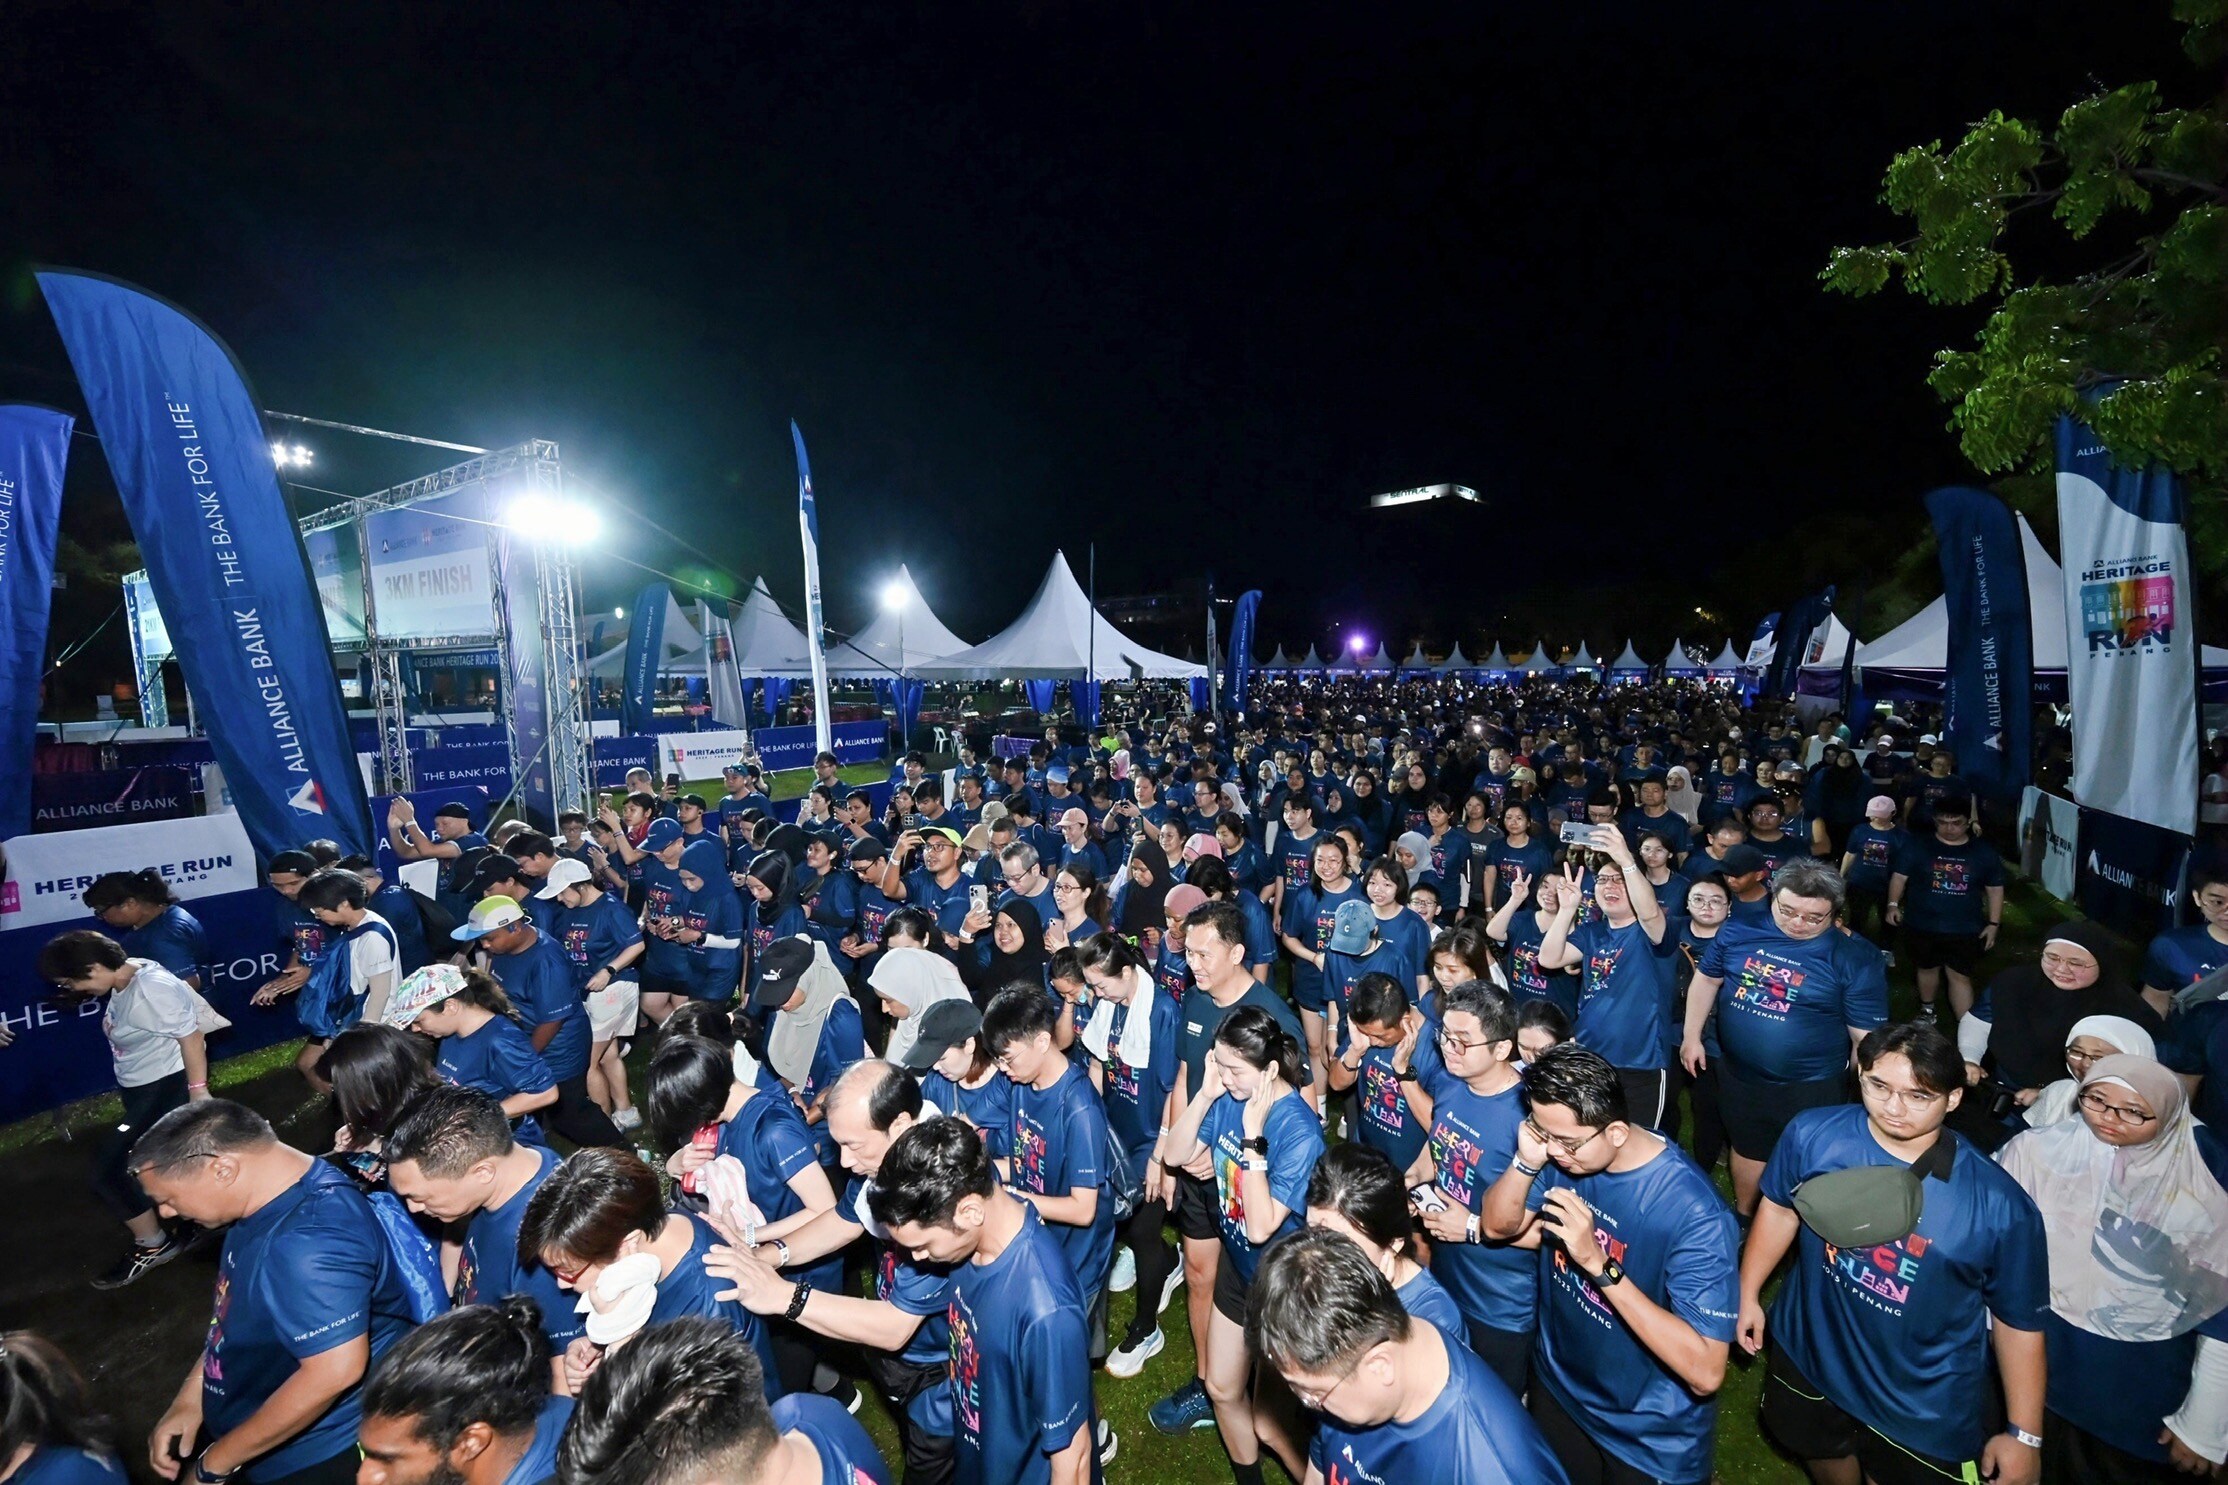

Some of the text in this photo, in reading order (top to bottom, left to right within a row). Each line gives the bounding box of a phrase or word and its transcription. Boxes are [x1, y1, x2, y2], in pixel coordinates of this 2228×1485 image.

[2076, 446, 2107, 457] ALLIA
[184, 445, 213, 485] FOR
[197, 491, 232, 544] BANK
[216, 550, 244, 586] THE
[2082, 562, 2170, 581] HERITAGE
[385, 564, 473, 600] 3KM FINISH
[233, 608, 273, 669] BANK
[1972, 534, 2002, 728] ALLIANCE BANK THE BANK FOR LIFE
[2088, 624, 2170, 652] RUN
[446, 654, 474, 666] HERITAGE
[475, 654, 489, 665] RUN
[490, 653, 500, 664] 20
[2090, 647, 2170, 659] PENANG
[2034, 682, 2050, 691] NK
[258, 674, 309, 773] ALLIANCE
[759, 741, 818, 753] THE BANK FOR LIFE
[844, 736, 885, 746] ALLIANCE BANK
[623, 757, 647, 765] BANK
[686, 748, 725, 757] HERITAGE
[423, 767, 506, 782] THE BANK FOR
[36, 797, 178, 821] ALLIANCE BANK
[182, 854, 232, 874] RUN
[166, 873, 208, 884] NANG
[1344, 924, 1350, 933] C
[211, 952, 280, 982] FOR
[1766, 953, 1802, 966] ALLIANCE BANK
[0, 1001, 59, 1030] HE
[1730, 1001, 1786, 1022] 2025 PENANG
[1377, 1123, 1402, 1137] PENANG
[1453, 1117, 1480, 1138] ALLIANCE BANK
[1218, 1134, 1244, 1162] HERIT
[1580, 1196, 1618, 1229] LLIANCE BANK
[1553, 1272, 1612, 1329] 2025 PENANG
[1852, 1288, 1902, 1316] PENANG
[1712, 1308, 1728, 1318] BANK
[293, 1332, 308, 1343] THE
[309, 1323, 329, 1338] BANK
[331, 1317, 347, 1330] FOR
[1048, 1418, 1065, 1429] BANK
[964, 1433, 980, 1450] ANG
